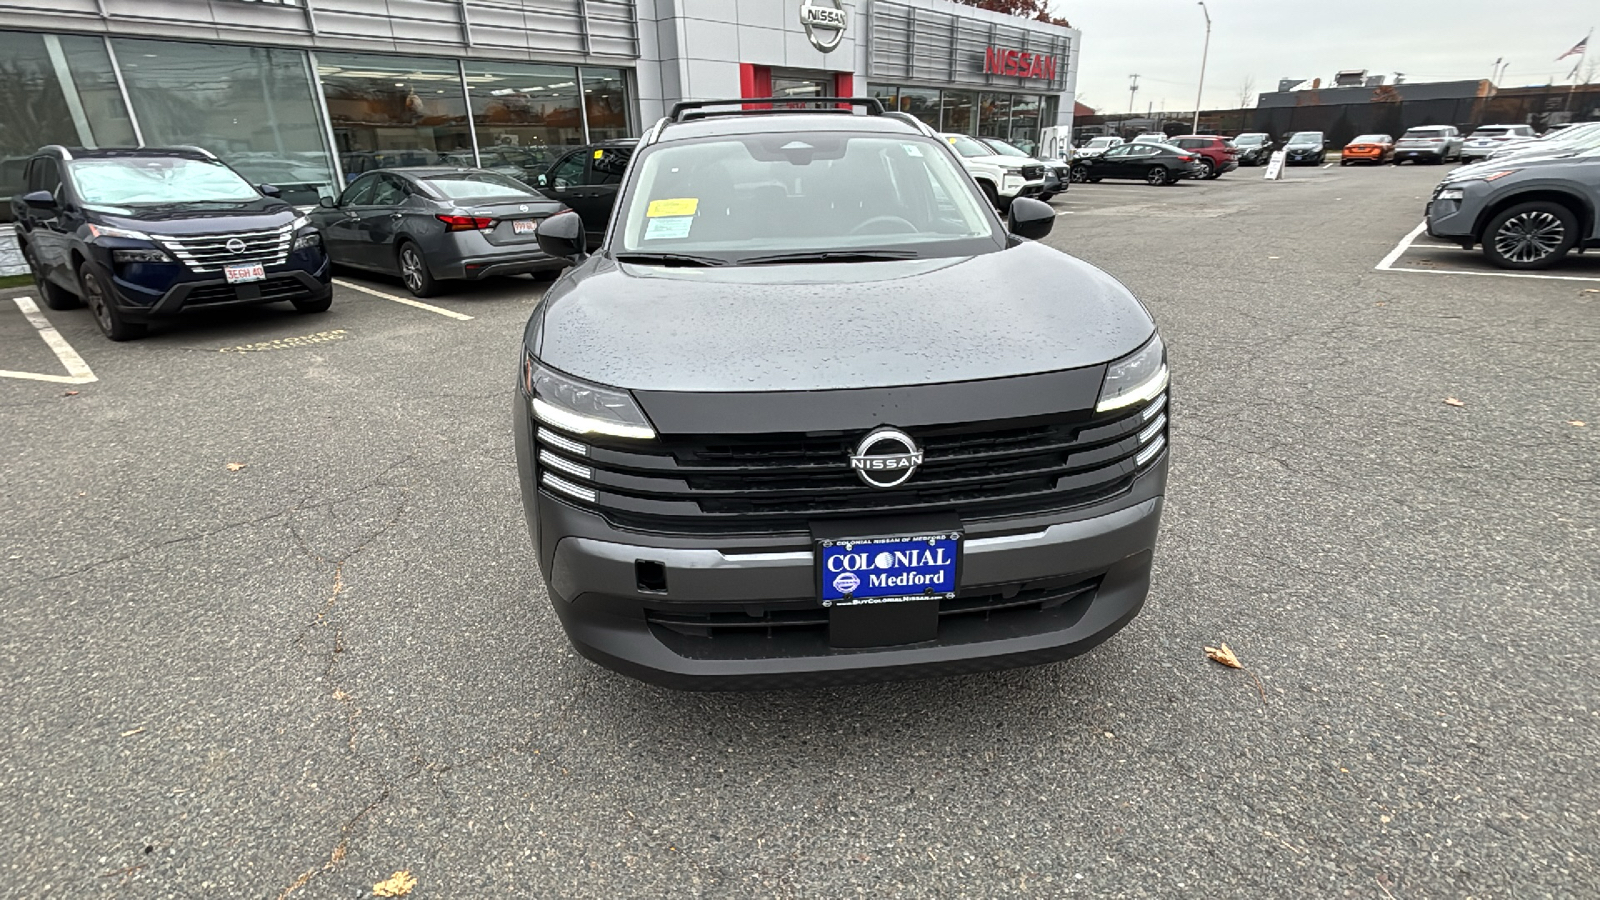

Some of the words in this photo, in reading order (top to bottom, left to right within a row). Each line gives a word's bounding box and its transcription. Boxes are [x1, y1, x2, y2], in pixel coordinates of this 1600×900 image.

[807, 9, 846, 26] NISSAN
[984, 46, 1057, 81] NISSAN
[851, 455, 923, 469] NISSAN
[836, 539, 872, 547] COLONIAL
[912, 534, 947, 542] MEDFORD
[827, 547, 951, 572] COLONIAL
[869, 569, 945, 588] Medford
